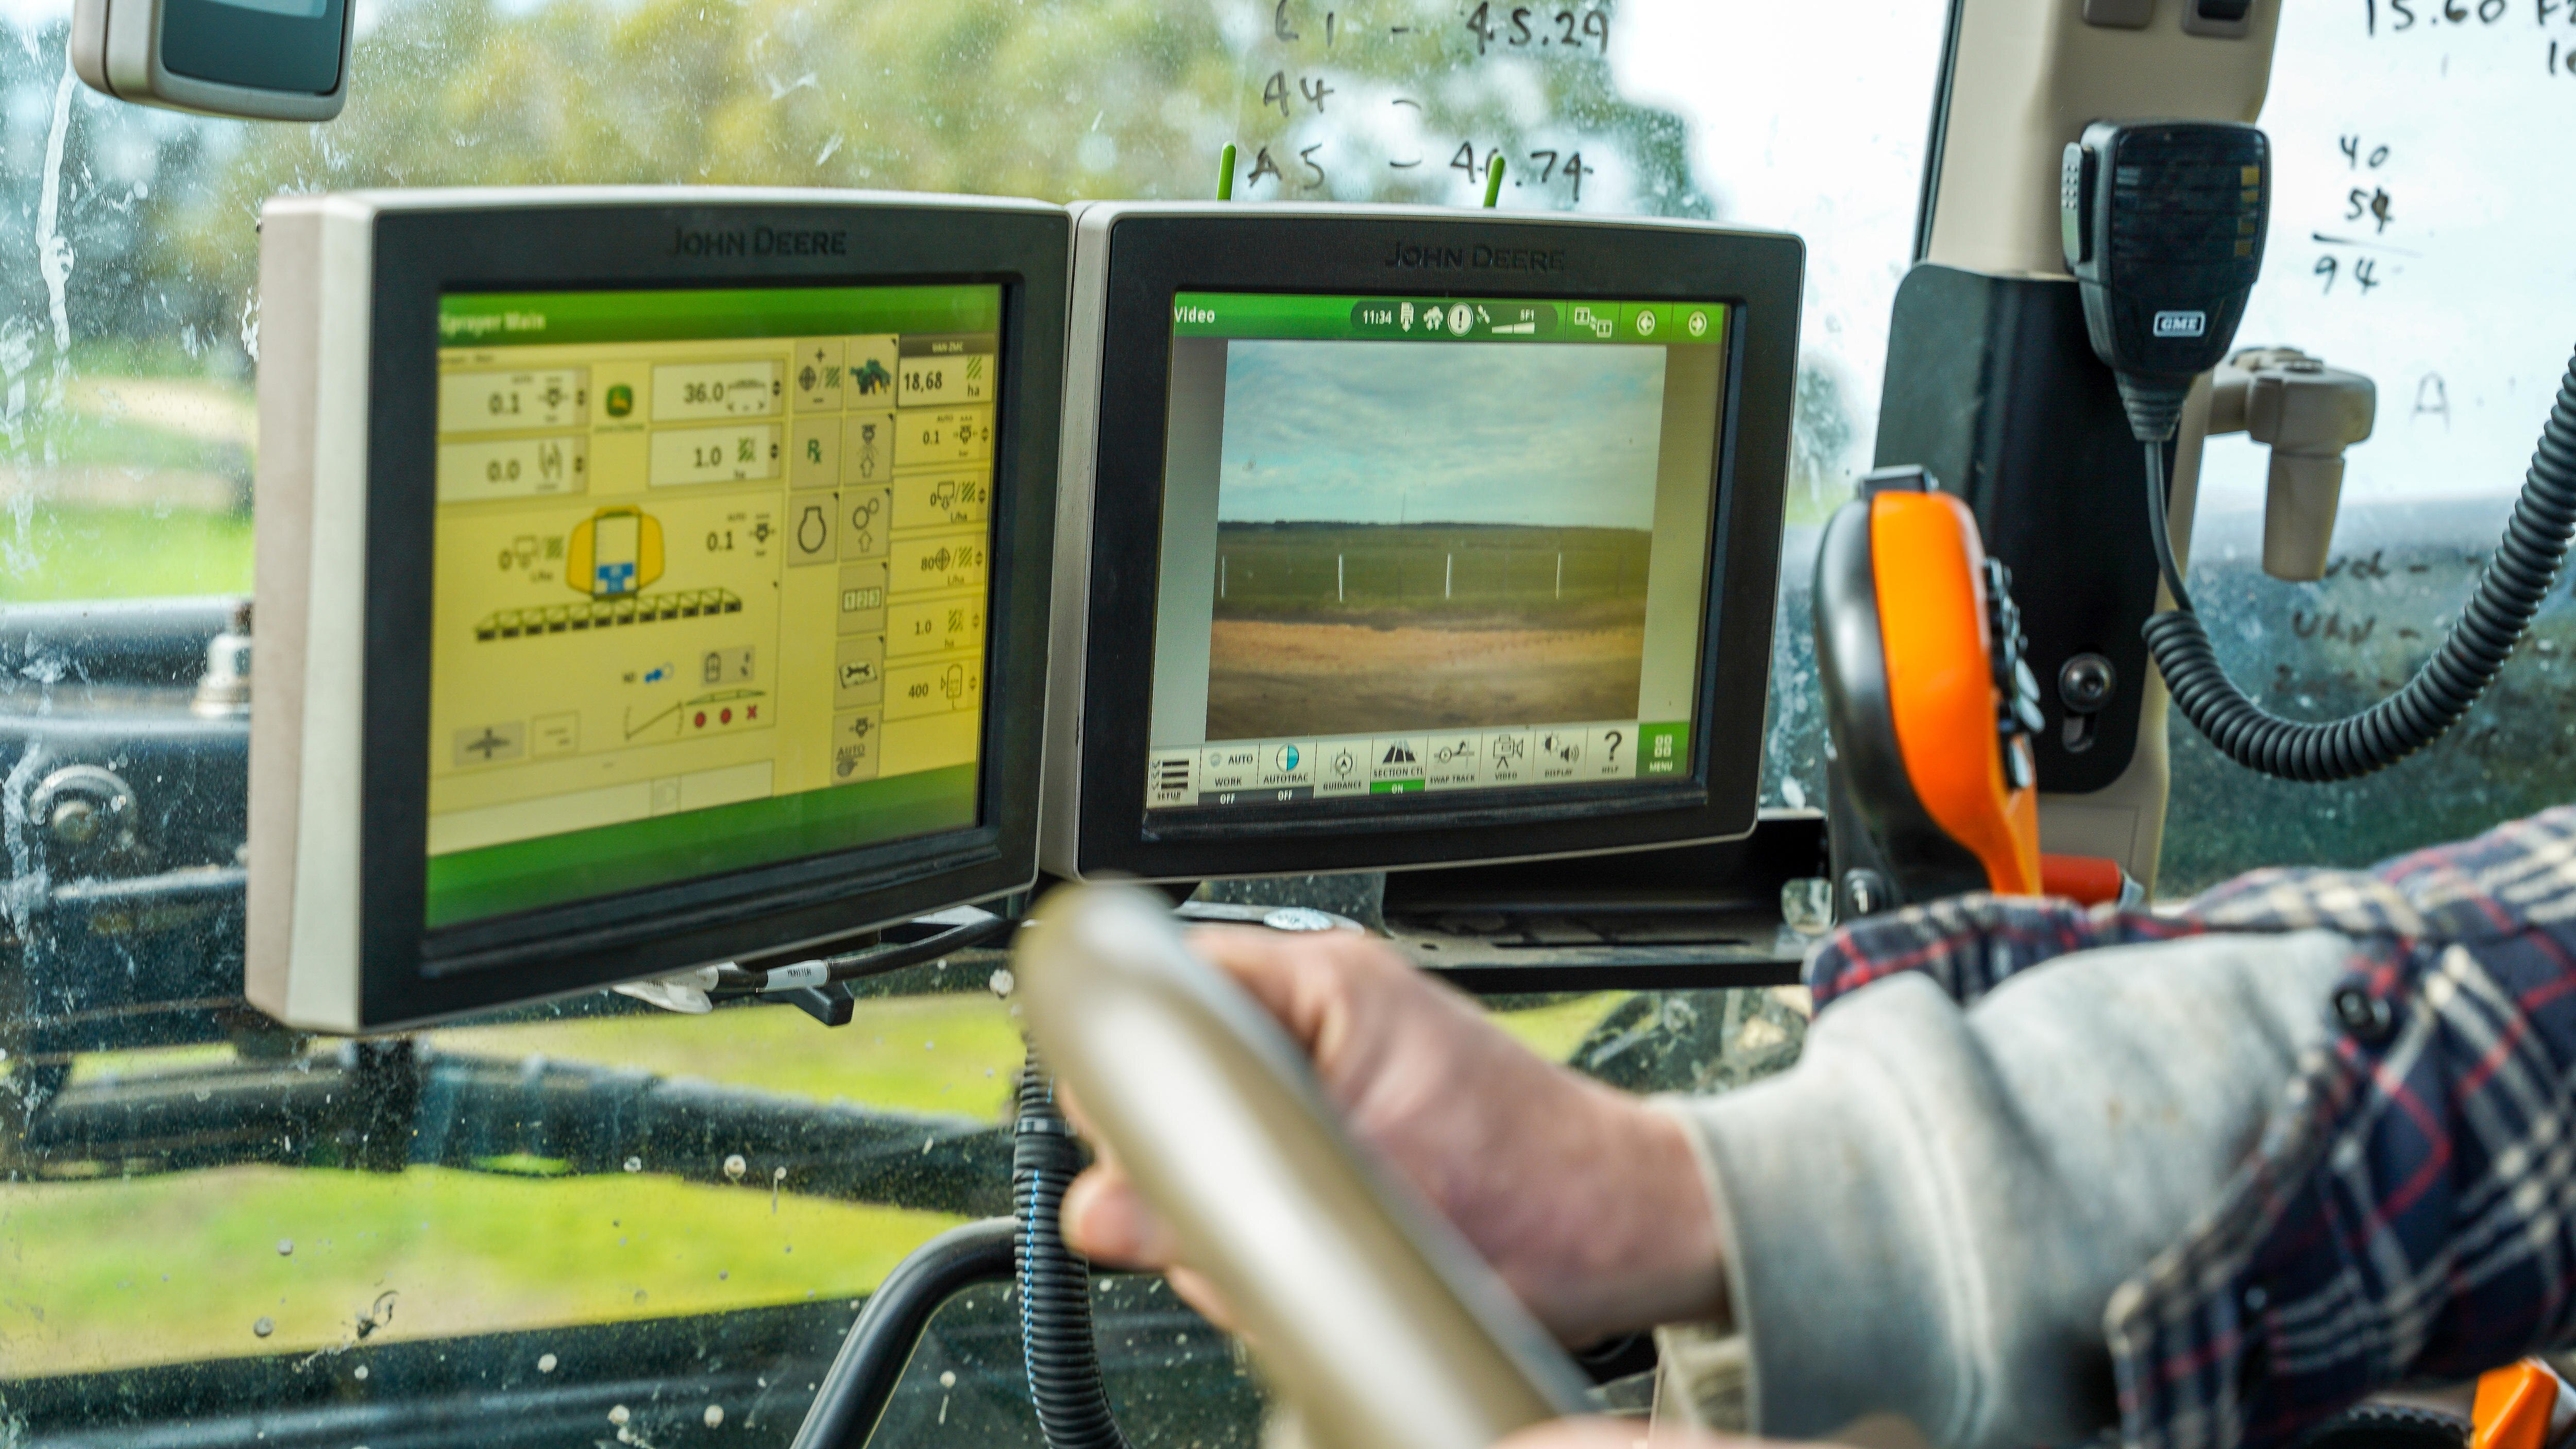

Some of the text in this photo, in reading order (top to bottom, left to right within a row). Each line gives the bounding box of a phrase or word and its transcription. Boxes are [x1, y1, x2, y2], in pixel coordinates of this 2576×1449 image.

[1466, 1, 1608, 55] 45.29
[1263, 70, 1334, 117] A4
[2340, 134, 2389, 170] 40
[1248, 143, 1325, 190] A5
[673, 225, 847, 257] JOHN DEERE
[1385, 239, 1565, 272] JOHN DEERE
[2313, 255, 2380, 295] 94
[505, 312, 547, 331] Main
[1174, 305, 1215, 323] Video
[1363, 309, 1392, 325] 11:34
[2160, 317, 2198, 330] GME
[903, 370, 942, 393] 18,68
[684, 380, 724, 404] 36.0
[488, 391, 520, 415] 0.1
[923, 430, 939, 445] 0.1
[694, 445, 722, 469] 1.0
[486, 457, 521, 484] 0.0
[706, 529, 734, 552] 0.1
[914, 619, 932, 635] 1.0
[908, 682, 929, 698] 400
[1228, 753, 1253, 766] AUTO
[1648, 760, 1673, 772] MENU
[1214, 776, 1242, 788] WORK
[1263, 772, 1309, 785] AUTOTRAC
[1374, 767, 1408, 779] SECTION
[1323, 780, 1363, 792] GUIDANCE
[1391, 783, 1404, 794] ON
[1219, 793, 1235, 805] OFF
[1277, 789, 1293, 802] OFF
